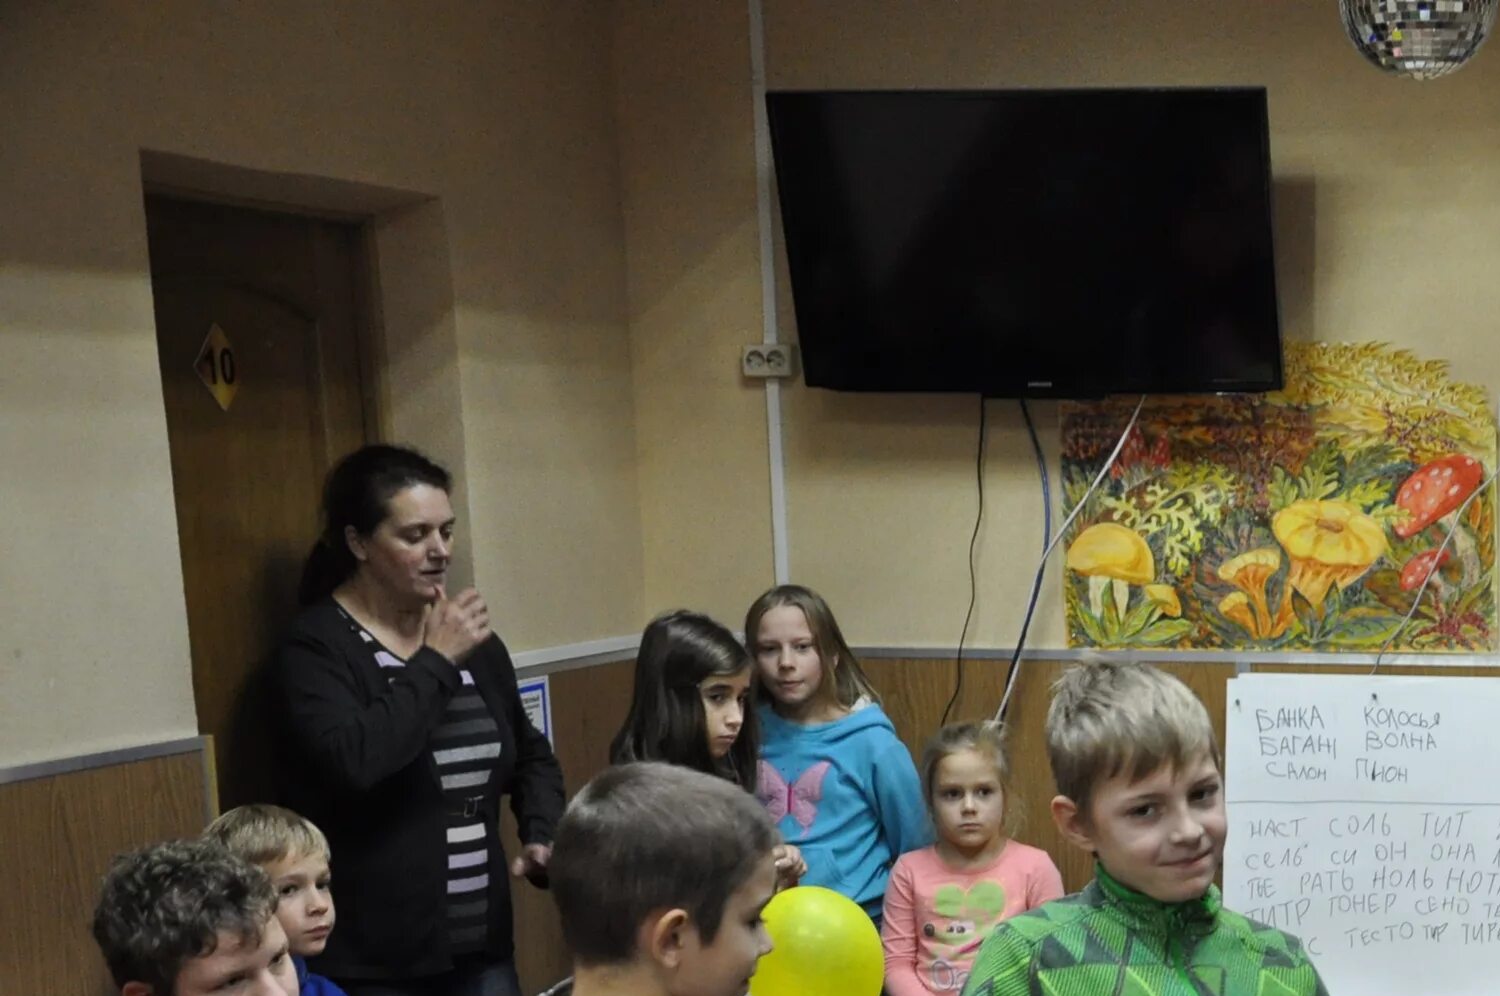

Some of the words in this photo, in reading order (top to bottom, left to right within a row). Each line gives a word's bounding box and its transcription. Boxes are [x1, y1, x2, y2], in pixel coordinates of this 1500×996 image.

[205, 346, 235, 385] 10
[1255, 705, 1325, 733] БАНКА
[1364, 706, 1440, 730] КОЛОСЬЯ
[1365, 730, 1437, 752] ВОЛНА
[1265, 761, 1327, 782] САЛОН
[1355, 758, 1408, 783] ПИОН
[1250, 817, 1307, 839] НАСТ
[1329, 812, 1391, 838] СОЛЬ
[1420, 810, 1472, 838] ТИТ
[1375, 841, 1407, 862] ОН
[1430, 842, 1477, 863] ОНА
[1300, 869, 1354, 895] РАТЬ
[1372, 866, 1434, 890] НОЛЬ
[1328, 893, 1398, 917] ТОНЕР
[1414, 896, 1470, 915] СЕНО
[1344, 921, 1414, 948] ТЕСТО
